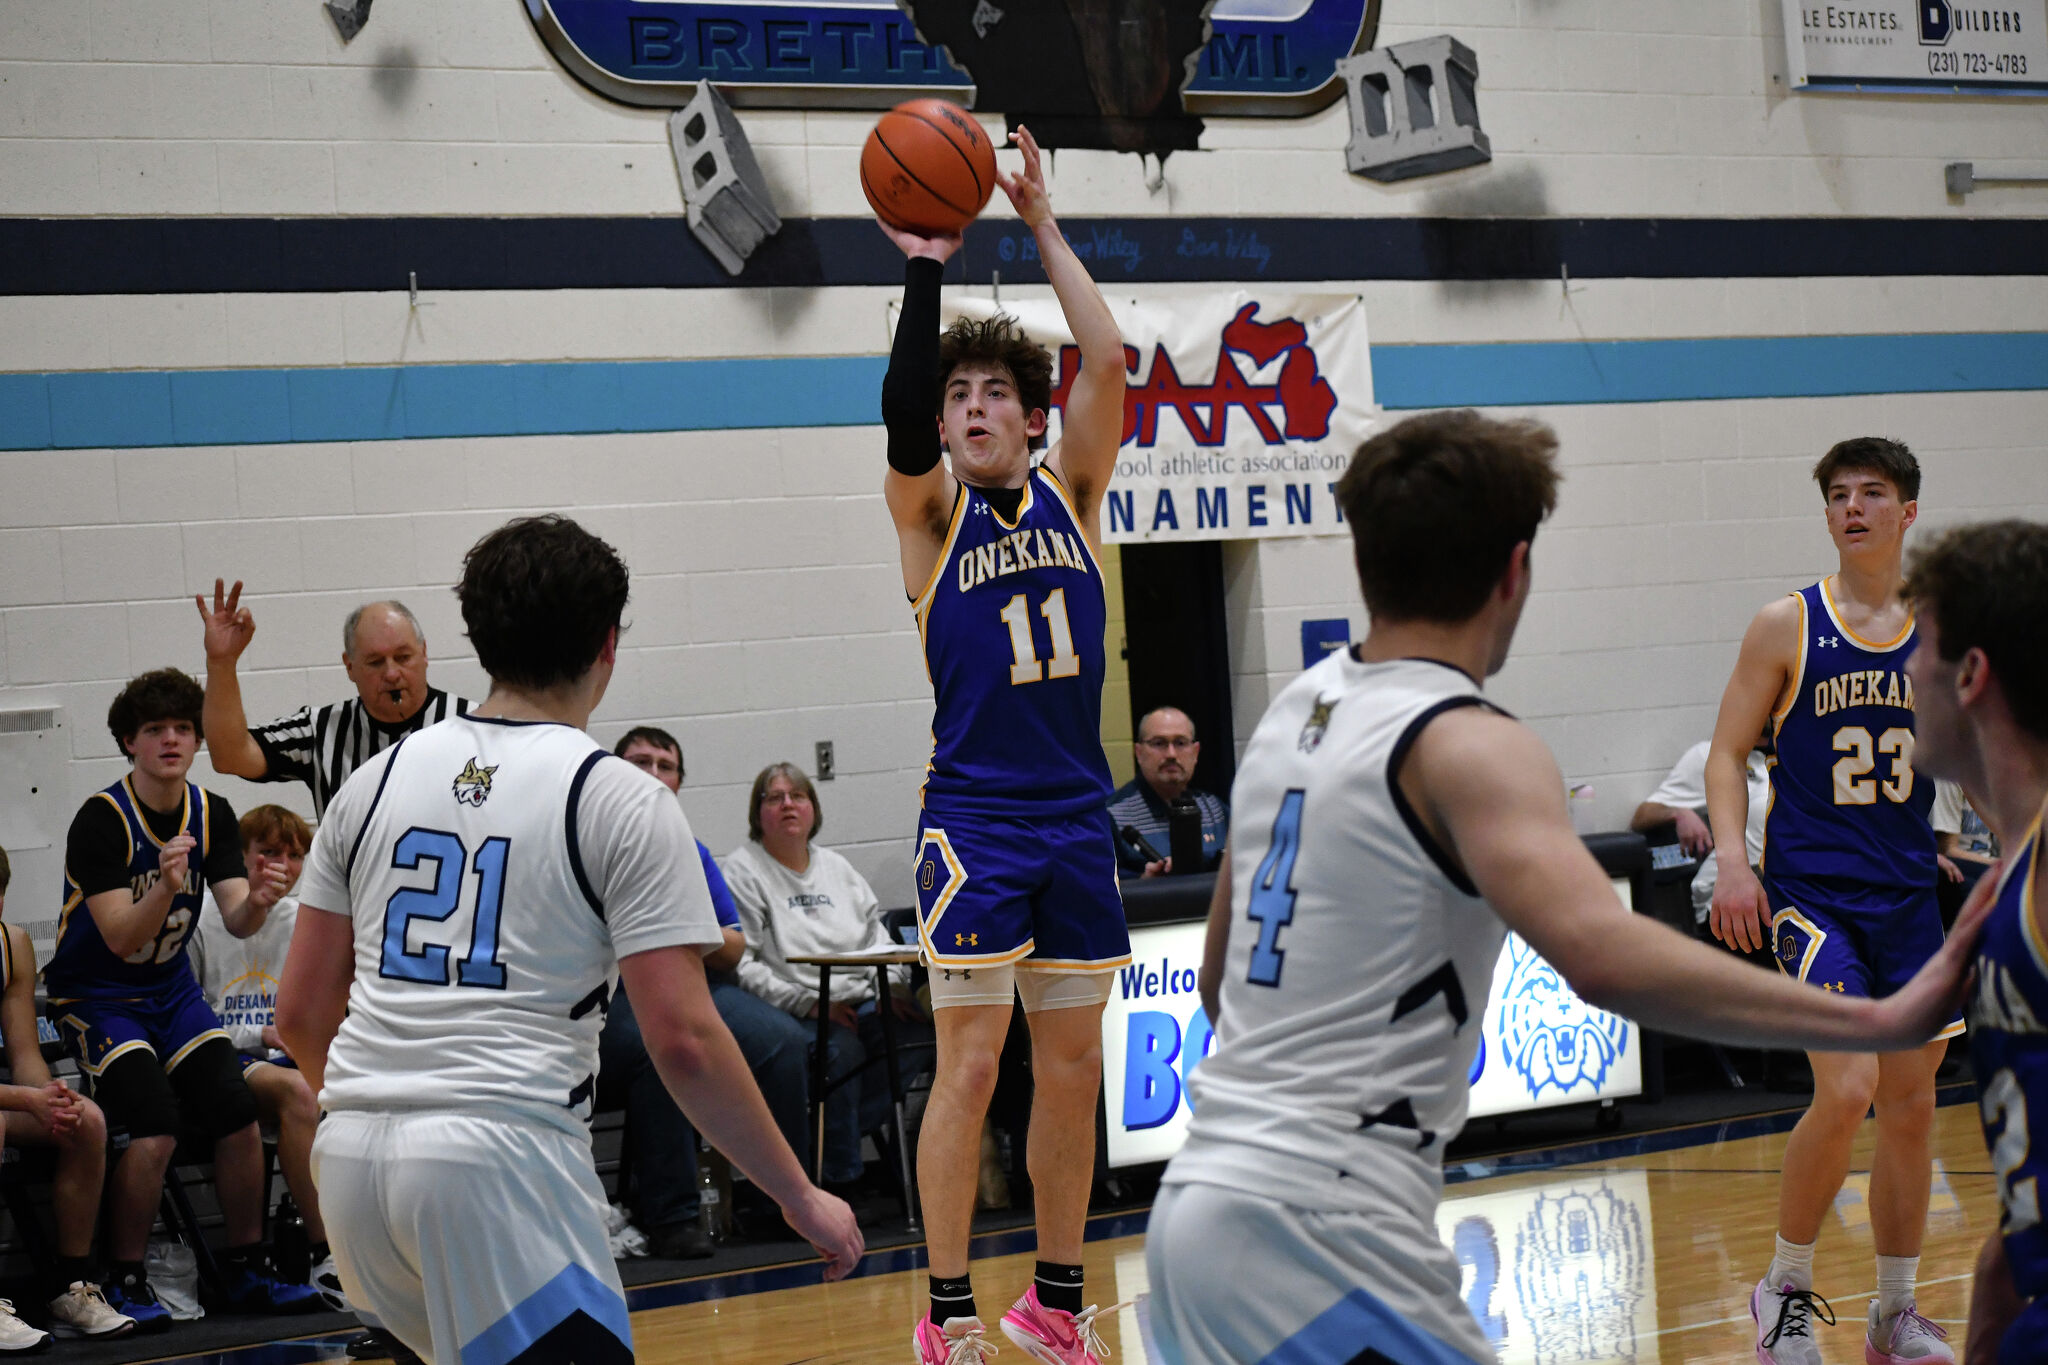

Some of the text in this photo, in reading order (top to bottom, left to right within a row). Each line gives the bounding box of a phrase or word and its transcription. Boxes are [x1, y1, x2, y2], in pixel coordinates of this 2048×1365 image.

[1825, 36, 1893, 46] MANAGEMENT
[1928, 51, 2027, 75] (231) 723-4783
[1160, 452, 1234, 476] athletic
[1242, 450, 1347, 474] association
[958, 528, 1089, 594] ONEKAMA
[1000, 587, 1081, 686] 11
[1832, 726, 1915, 805] 23
[379, 826, 512, 990] 21
[1246, 788, 1306, 988] 4
